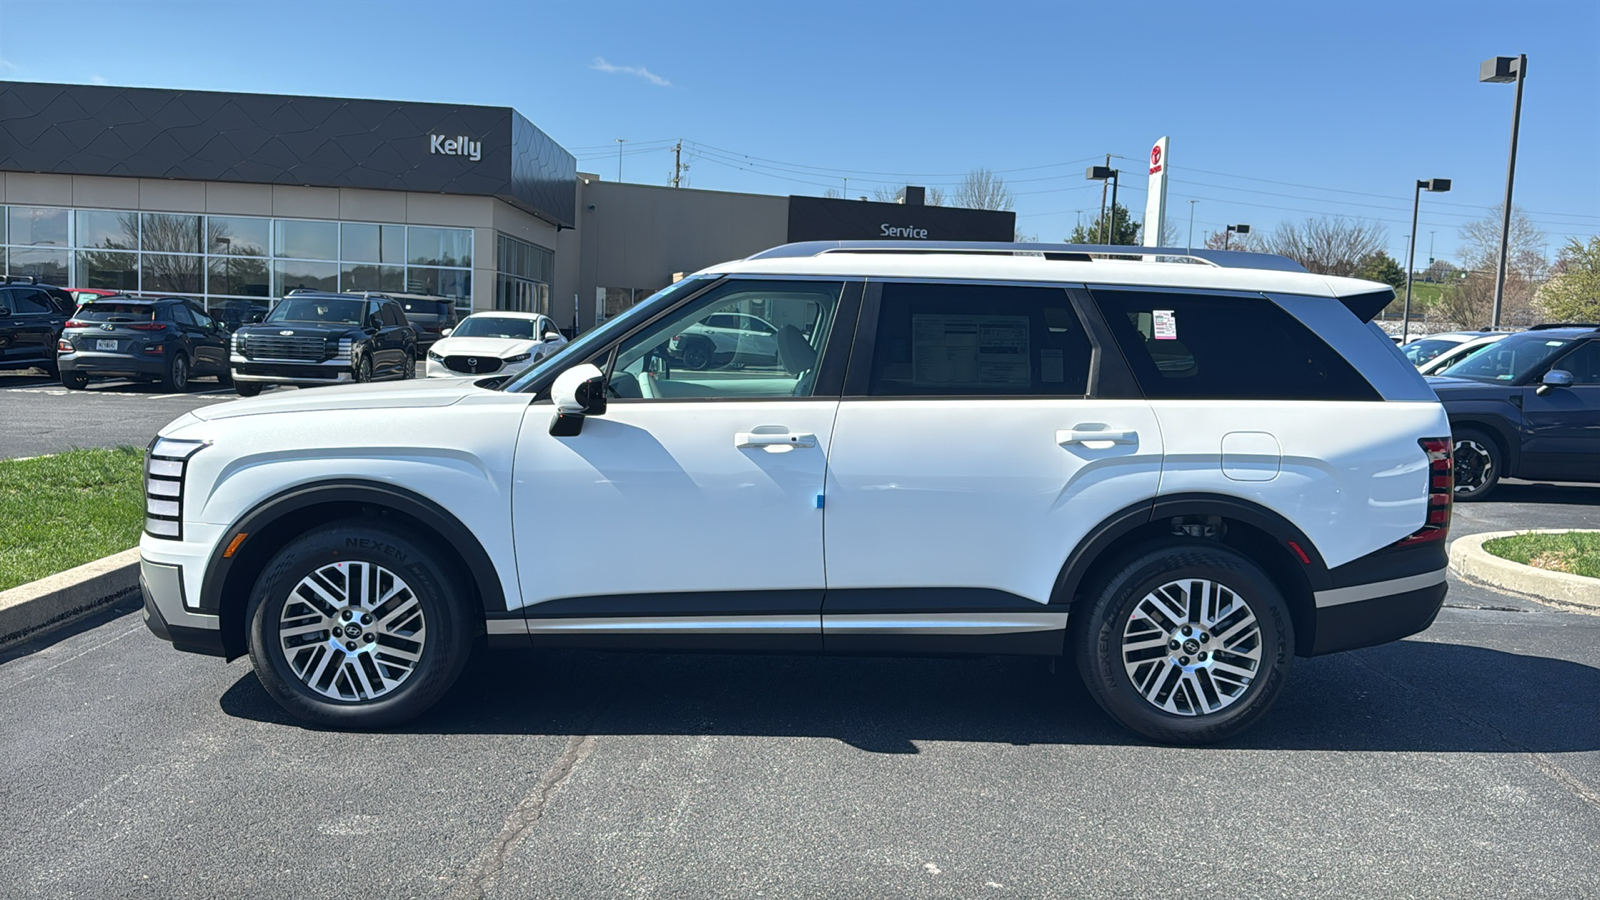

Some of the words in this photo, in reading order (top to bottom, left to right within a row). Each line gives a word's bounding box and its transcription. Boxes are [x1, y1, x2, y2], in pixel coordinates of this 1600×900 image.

[430, 134, 482, 161] Kelly
[880, 223, 928, 239] Service
[345, 538, 407, 561] NEXEN
[1269, 605, 1286, 665] NEXEN
[1099, 630, 1118, 691] NEXEN
